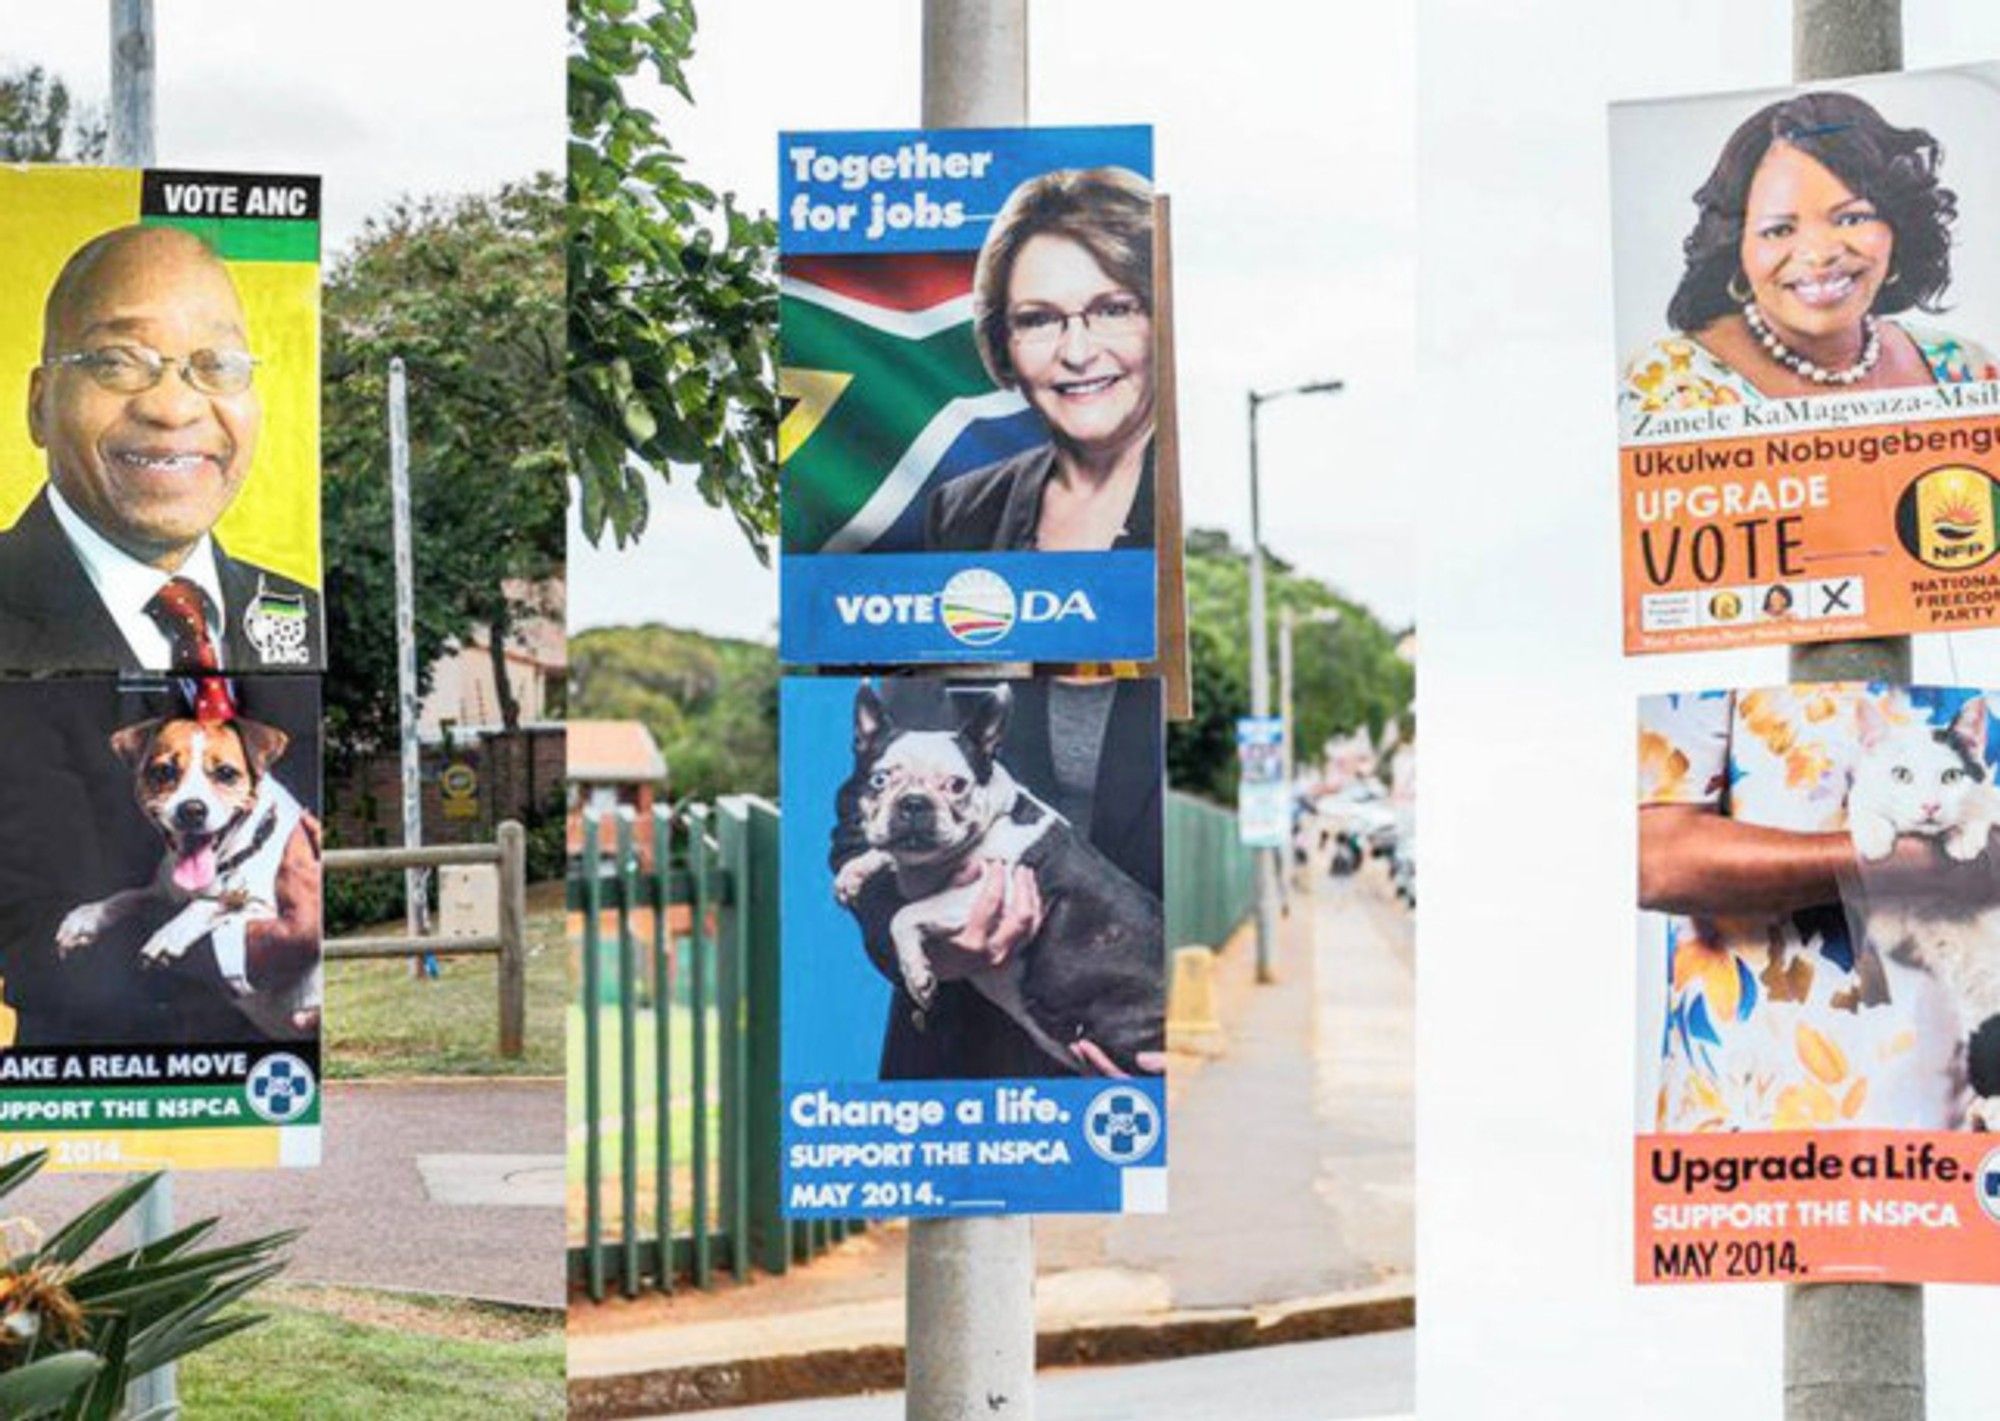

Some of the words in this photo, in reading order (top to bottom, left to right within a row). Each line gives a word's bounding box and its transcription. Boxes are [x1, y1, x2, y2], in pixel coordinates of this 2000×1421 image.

[790, 142, 993, 191] Together
[163, 183, 239, 213] VOTE
[245, 185, 308, 216] ANC
[790, 193, 858, 231] for
[866, 192, 965, 240] jobs
[1633, 408, 1731, 437] Zanele
[1634, 447, 1755, 478] Ukulwa
[1635, 475, 1829, 522] UPGRADE
[1641, 515, 1805, 586] VOTE
[836, 593, 935, 625] VOTE
[1020, 589, 1096, 622] DA
[1931, 605, 1996, 622] PARTY
[62, 1055, 84, 1078] A
[90, 1054, 160, 1078] REAL
[168, 1052, 248, 1077] MOVE
[101, 1100, 150, 1118] THE
[157, 1097, 241, 1118] NSPCA
[790, 1089, 945, 1135] Change
[955, 1099, 984, 1125] a
[996, 1087, 1071, 1124] life.
[790, 1142, 915, 1168] SUPPORT
[920, 1141, 971, 1166] THE
[977, 1139, 1071, 1165] NSPCA
[1651, 1142, 1843, 1193] Upgrade
[1850, 1155, 1878, 1179] a
[1884, 1143, 1974, 1183] Life.
[790, 1183, 854, 1209] MAY
[861, 1181, 945, 1207] 2014.
[1652, 1202, 1790, 1231] SUPPORT
[1796, 1201, 1850, 1227] THE
[1858, 1200, 1960, 1227] NSPCA
[1653, 1243, 1718, 1278] MAY
[1725, 1241, 1809, 1276] 2014.
